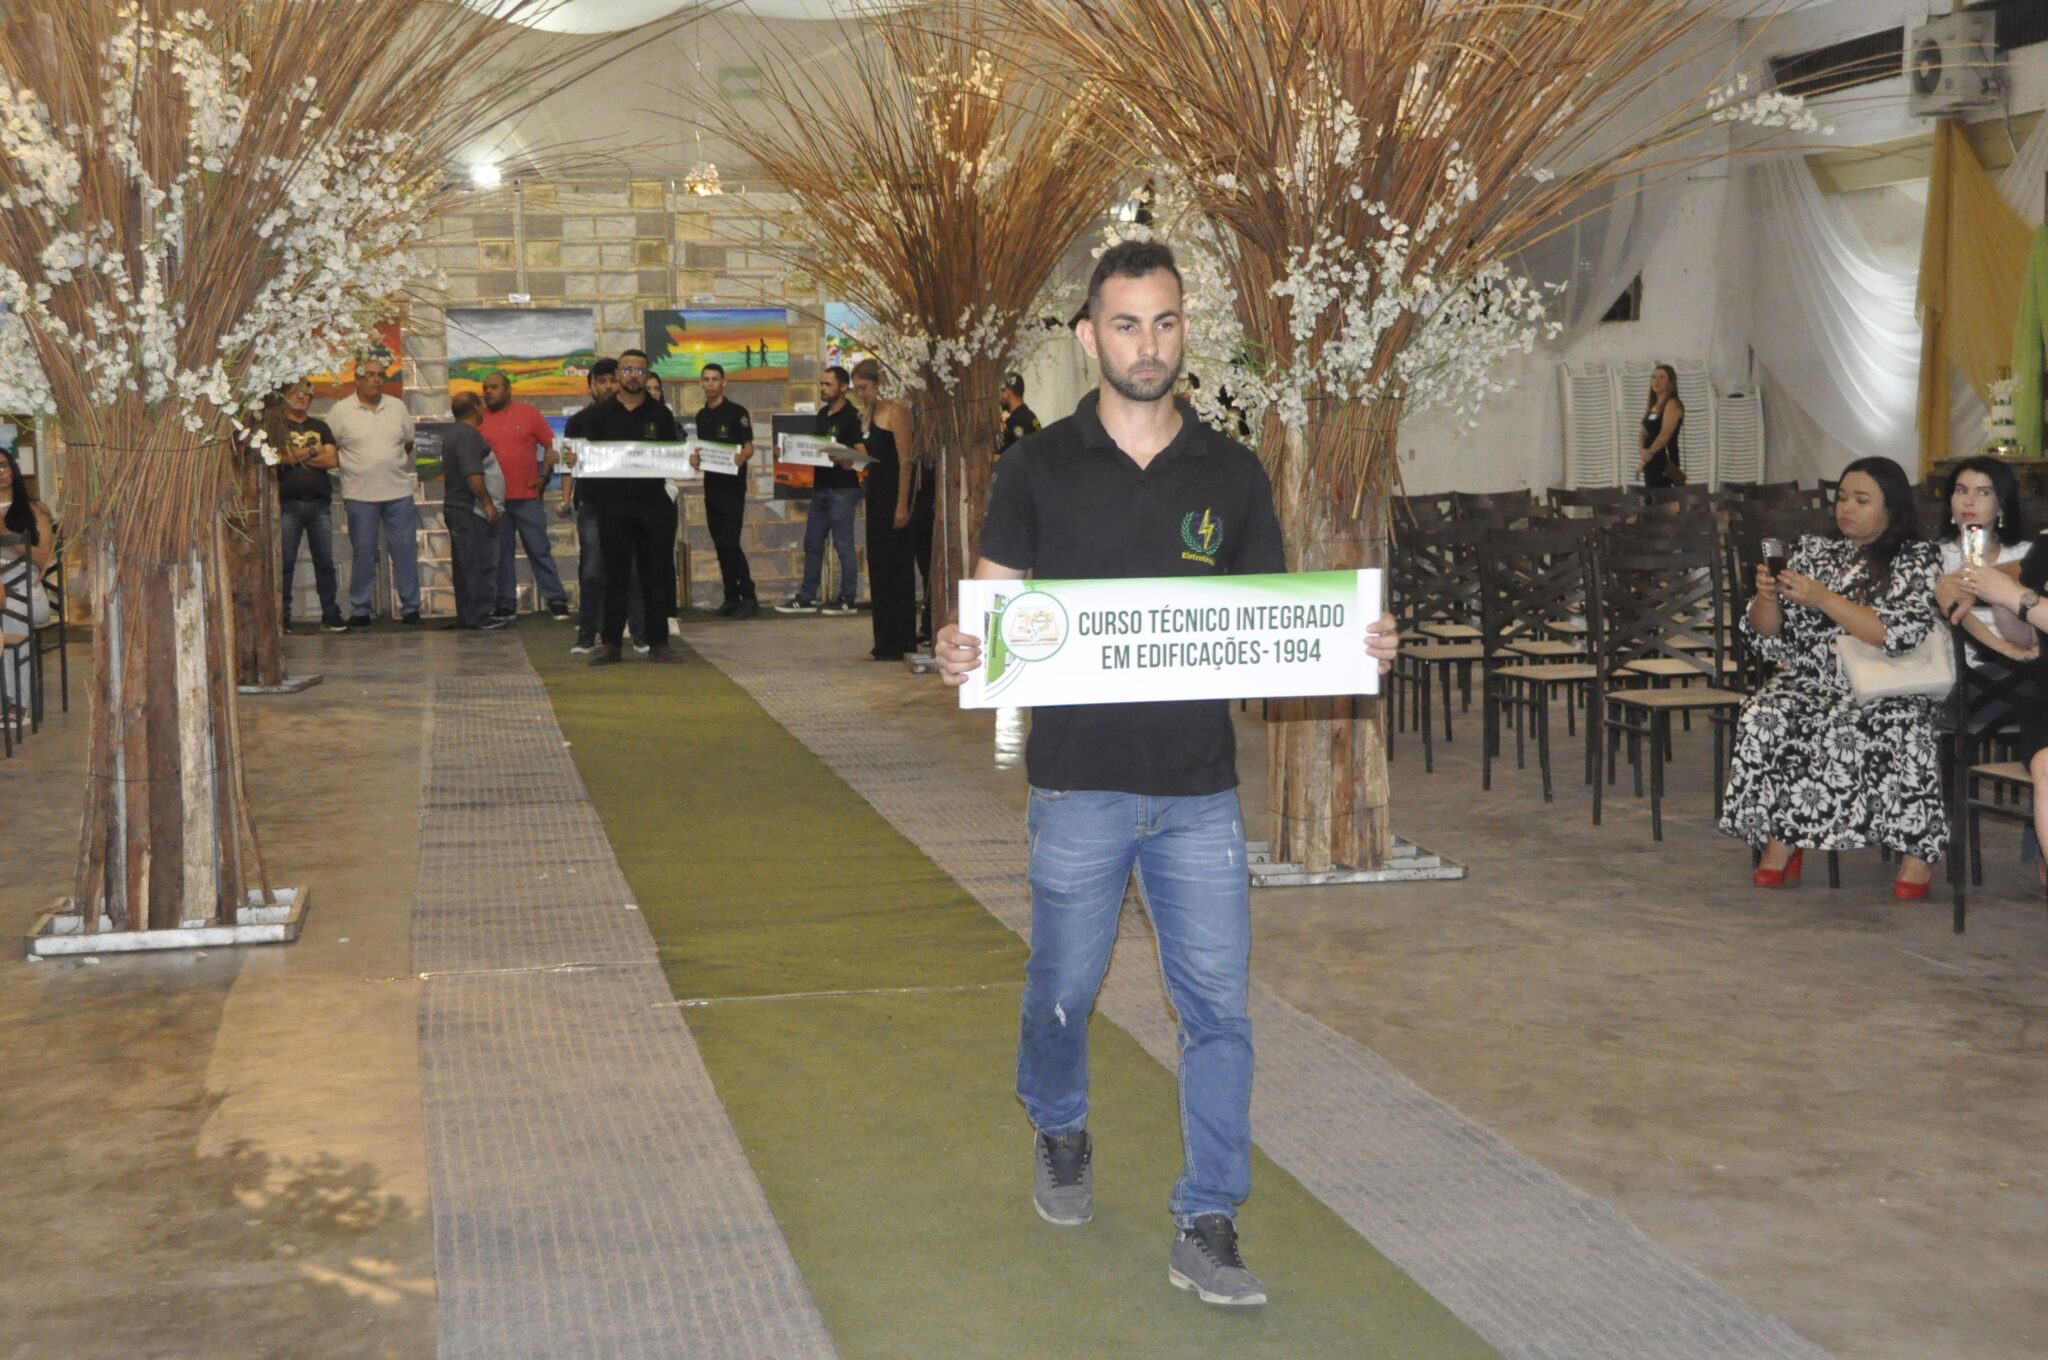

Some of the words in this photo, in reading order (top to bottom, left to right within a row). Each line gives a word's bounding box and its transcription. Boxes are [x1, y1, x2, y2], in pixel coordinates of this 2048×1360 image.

[1078, 611, 1142, 636] CURSO
[1148, 604, 1230, 633] TÉCNICO
[1236, 604, 1344, 631] INTEGRADO
[1102, 645, 1130, 669] EM
